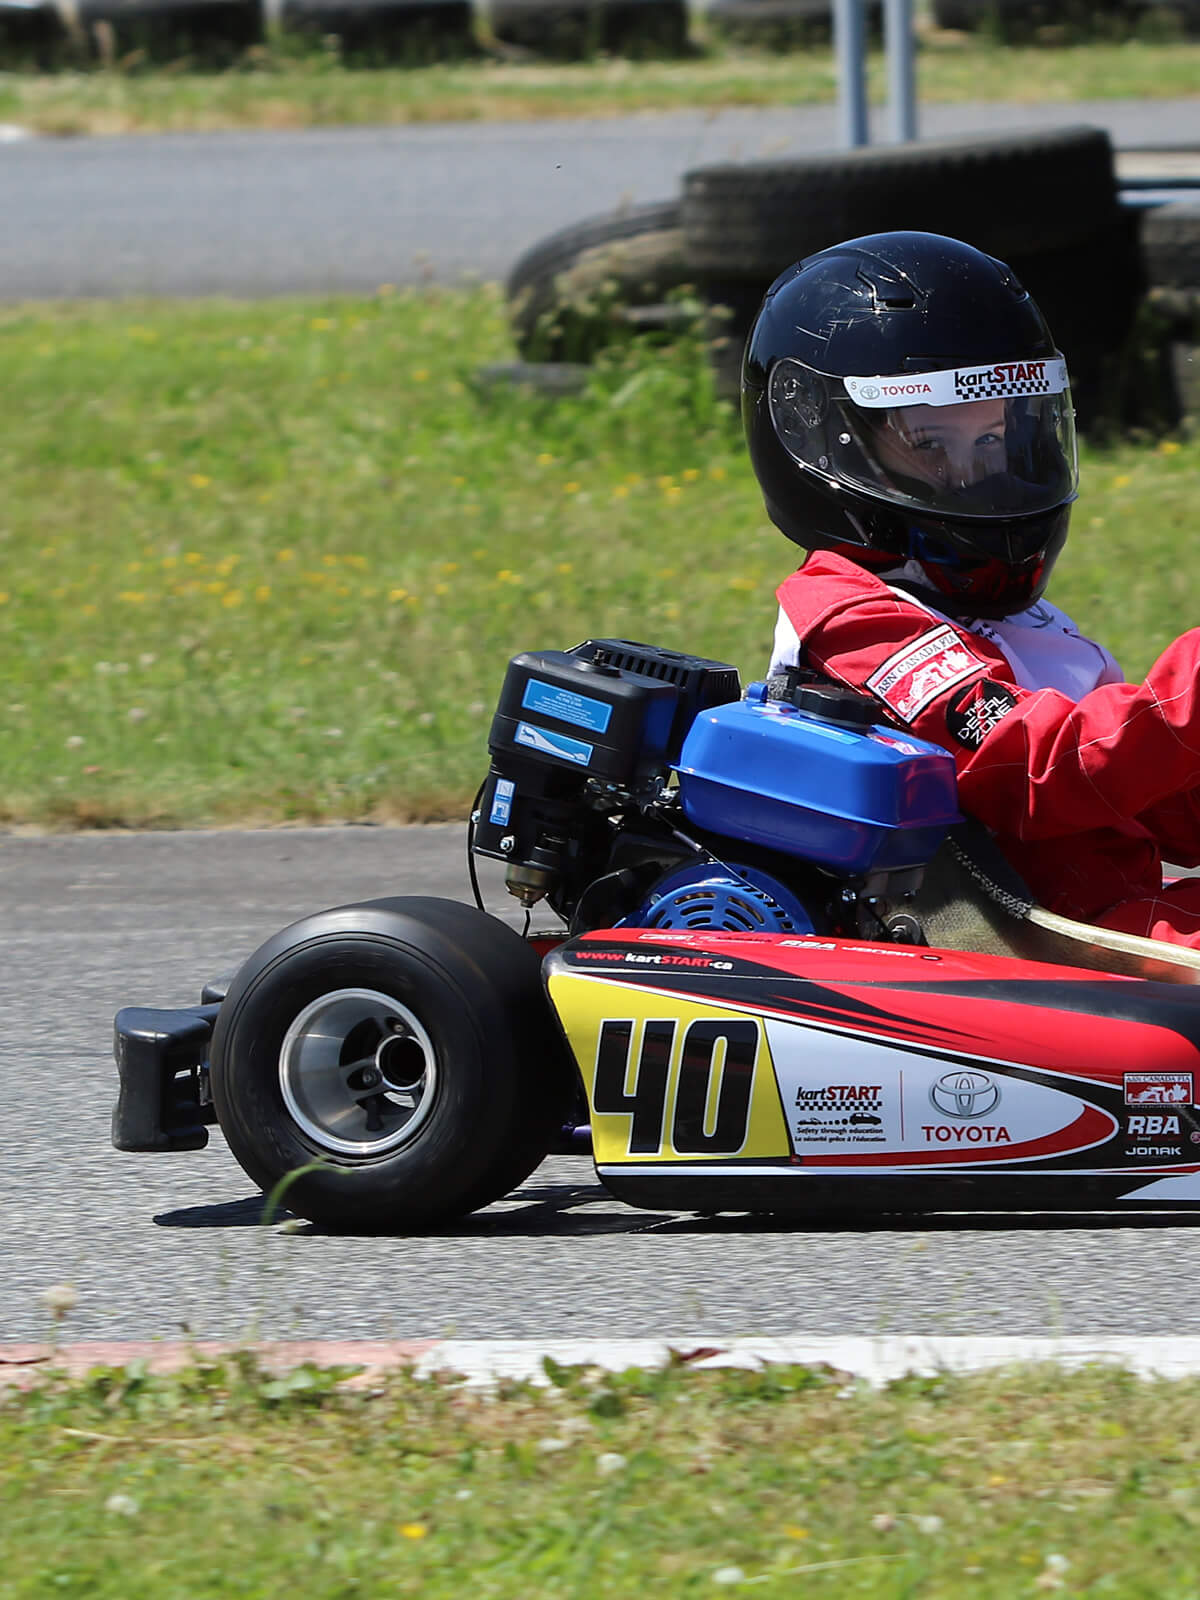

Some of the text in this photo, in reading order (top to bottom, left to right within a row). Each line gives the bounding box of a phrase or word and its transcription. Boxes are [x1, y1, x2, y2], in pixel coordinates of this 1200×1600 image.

[954, 362, 1046, 388] kartSTART
[880, 382, 932, 397] TOYOTA
[878, 633, 957, 695] ASN CANADA FIA
[964, 698, 986, 717] THE
[957, 696, 1008, 740] DECAL
[969, 702, 1013, 745] ZONE
[575, 951, 733, 971] www.kartSTART.ca
[593, 1018, 759, 1156] 40
[796, 1086, 882, 1101] kartSTART
[921, 1126, 1011, 1143] TOYOTA
[1127, 1115, 1181, 1135] RBA
[1125, 1146, 1182, 1156] JONAK
